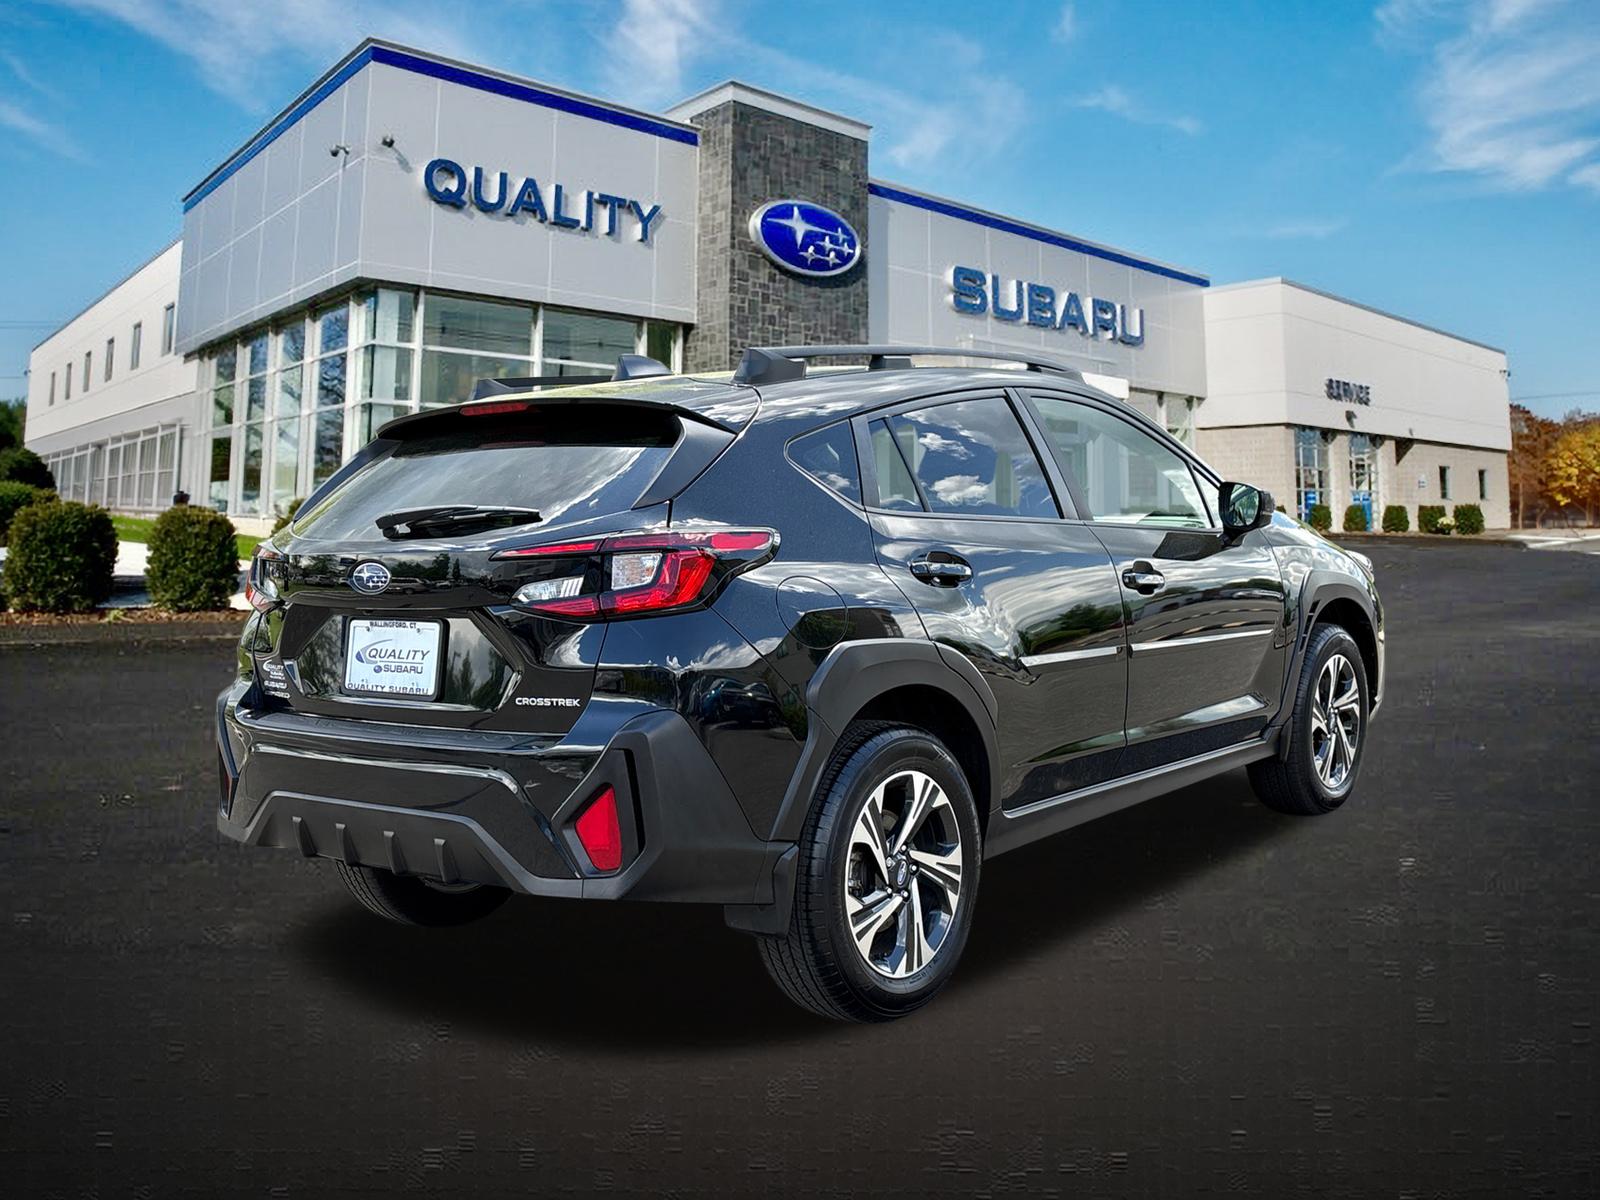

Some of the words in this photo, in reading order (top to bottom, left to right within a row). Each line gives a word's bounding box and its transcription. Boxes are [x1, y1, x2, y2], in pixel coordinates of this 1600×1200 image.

[424, 158, 661, 242] QUALITY
[951, 265, 1145, 347] SUBARU
[1324, 378, 1370, 406] SERVICE
[368, 648, 430, 660] QUALITY
[383, 665, 423, 674] SUBARU
[347, 683, 386, 691] QUALITY
[389, 685, 429, 695] SUBARU
[515, 697, 581, 707] CROSSTREK
